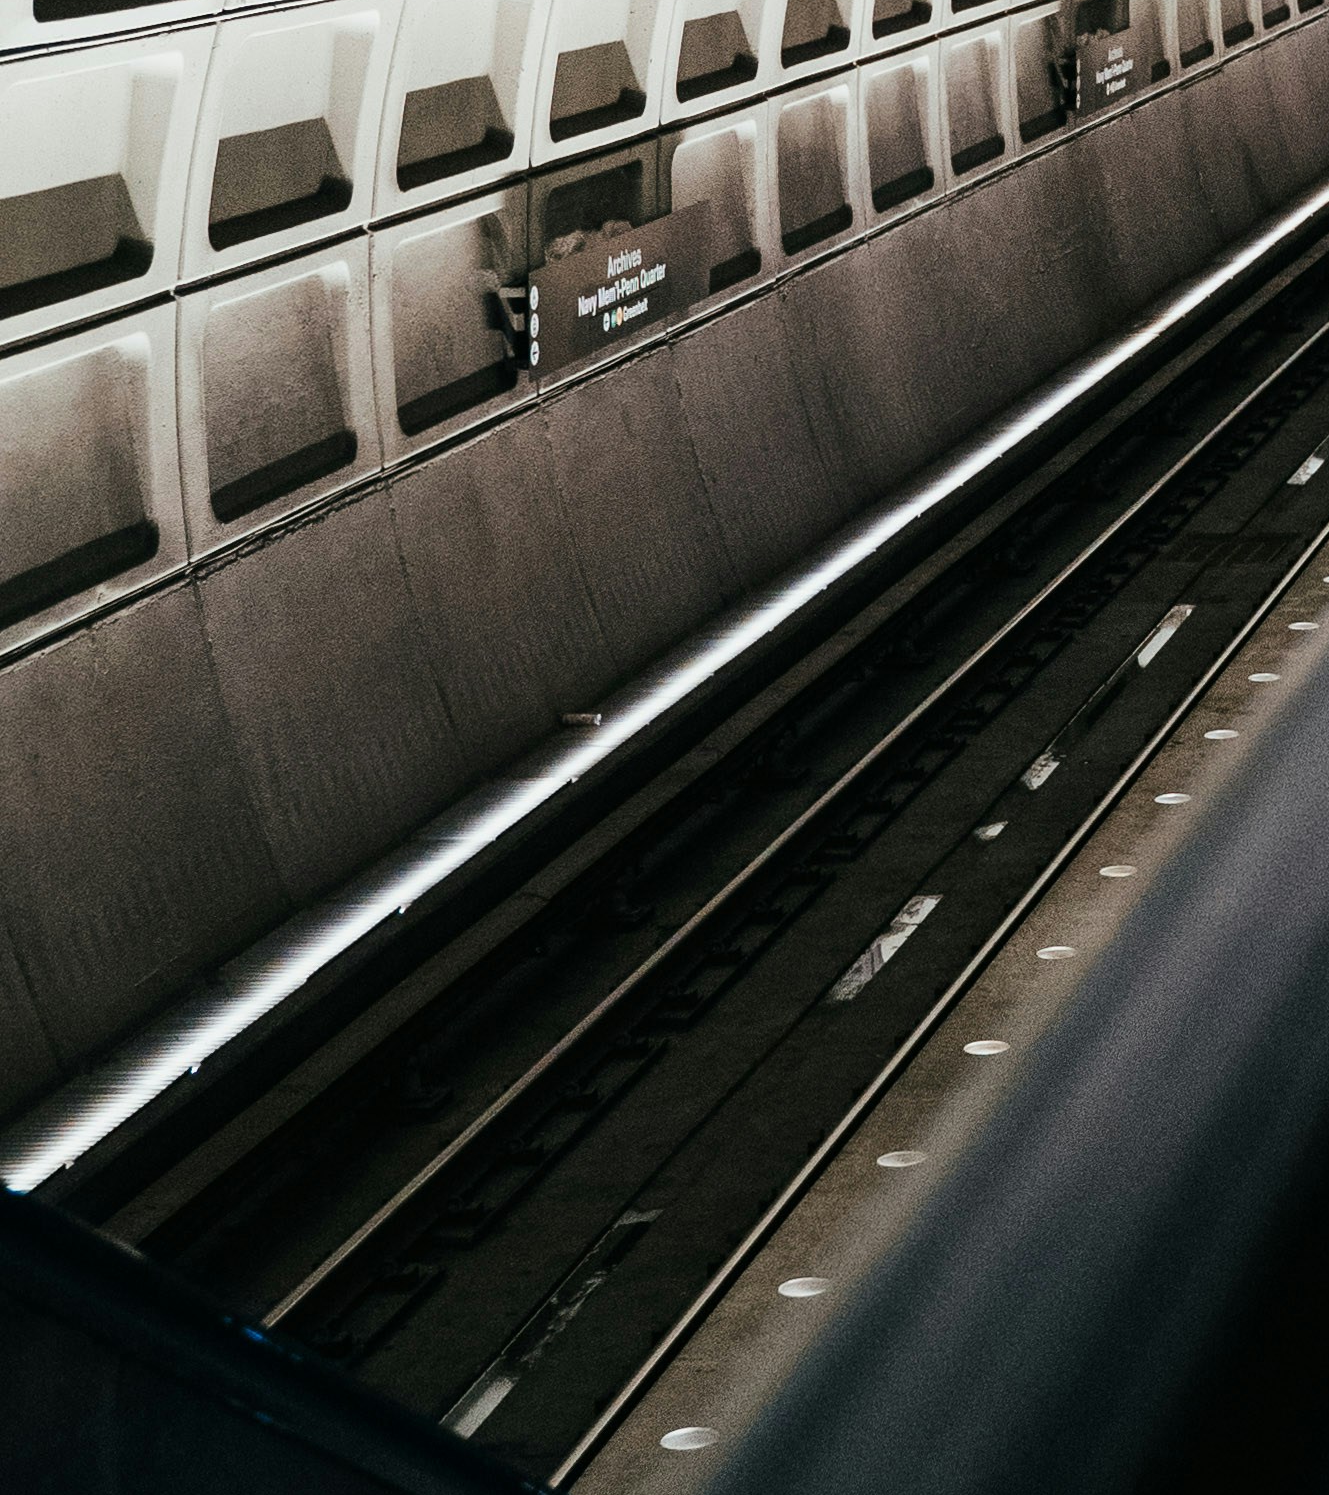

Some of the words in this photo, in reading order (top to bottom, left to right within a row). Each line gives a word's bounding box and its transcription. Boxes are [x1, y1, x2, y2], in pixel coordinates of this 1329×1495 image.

[608, 249, 642, 278] Archives
[578, 295, 597, 318] Navy
[640, 264, 666, 289] Quarter
